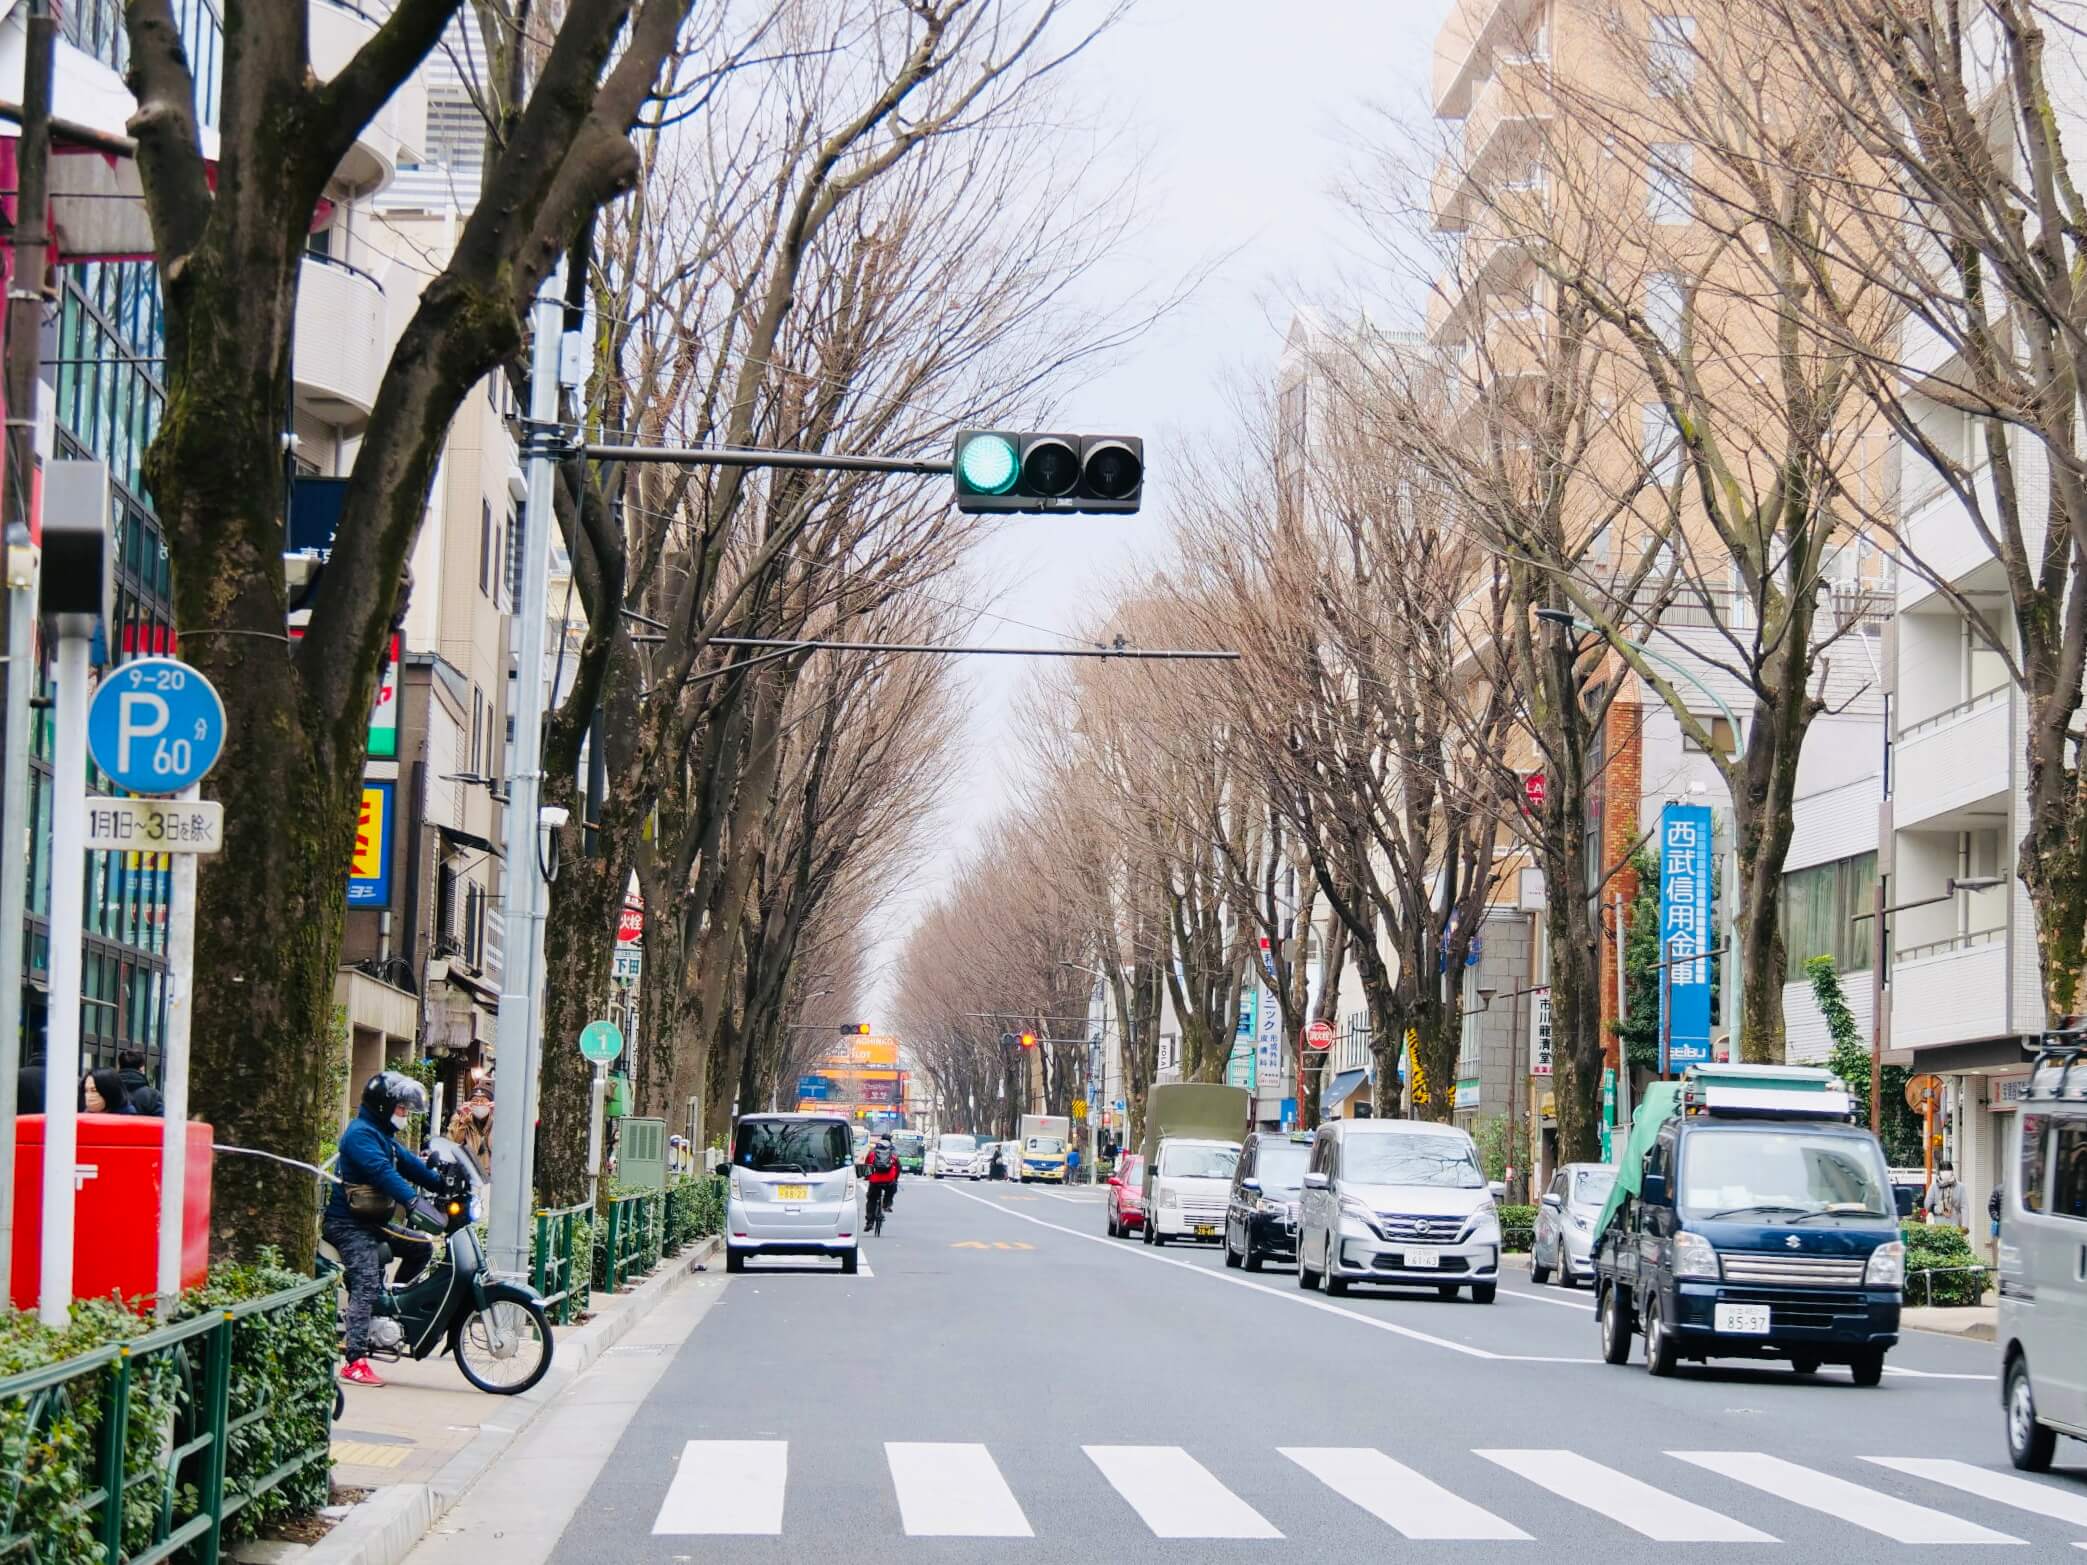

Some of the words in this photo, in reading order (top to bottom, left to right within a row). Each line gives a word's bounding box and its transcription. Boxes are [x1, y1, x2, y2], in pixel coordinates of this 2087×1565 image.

[129, 670, 185, 690] 9-20
[117, 692, 170, 774] P
[194, 718, 208, 741] 分
[153, 738, 192, 775] 60
[619, 913, 642, 931] 火栓
